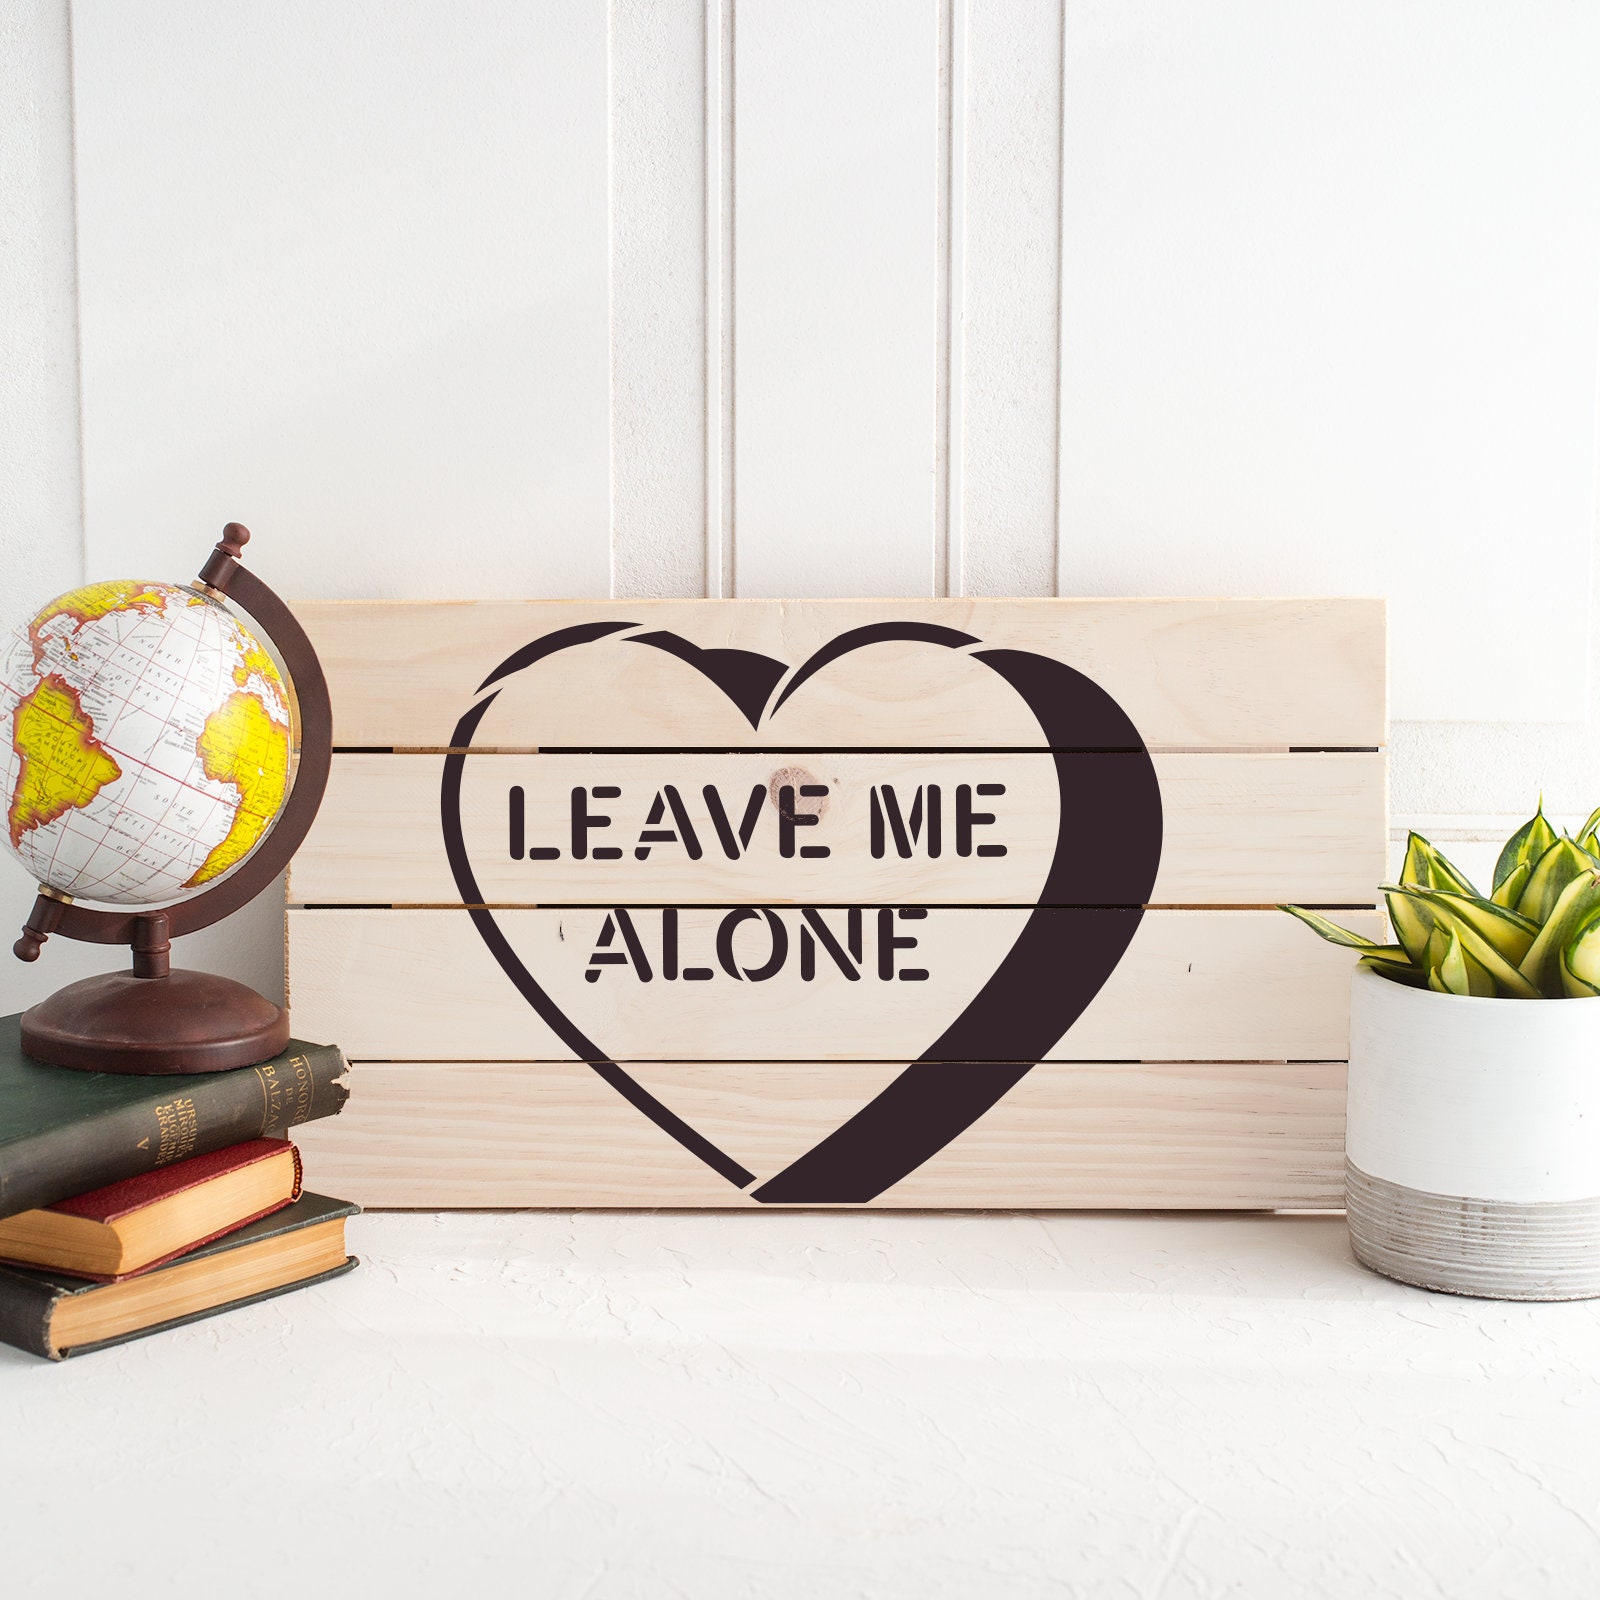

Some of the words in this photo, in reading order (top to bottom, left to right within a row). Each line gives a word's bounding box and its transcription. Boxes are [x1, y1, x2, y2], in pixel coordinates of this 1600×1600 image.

[138, 638, 182, 665] NORTH
[114, 674, 161, 702] OCEAN
[153, 793, 195, 816] SOUTH
[509, 784, 831, 861] LEAVE
[870, 784, 1008, 859] ME
[585, 908, 930, 983] ALONE
[262, 1065, 281, 1130] BALZAC
[136, 1136, 149, 1150] V
